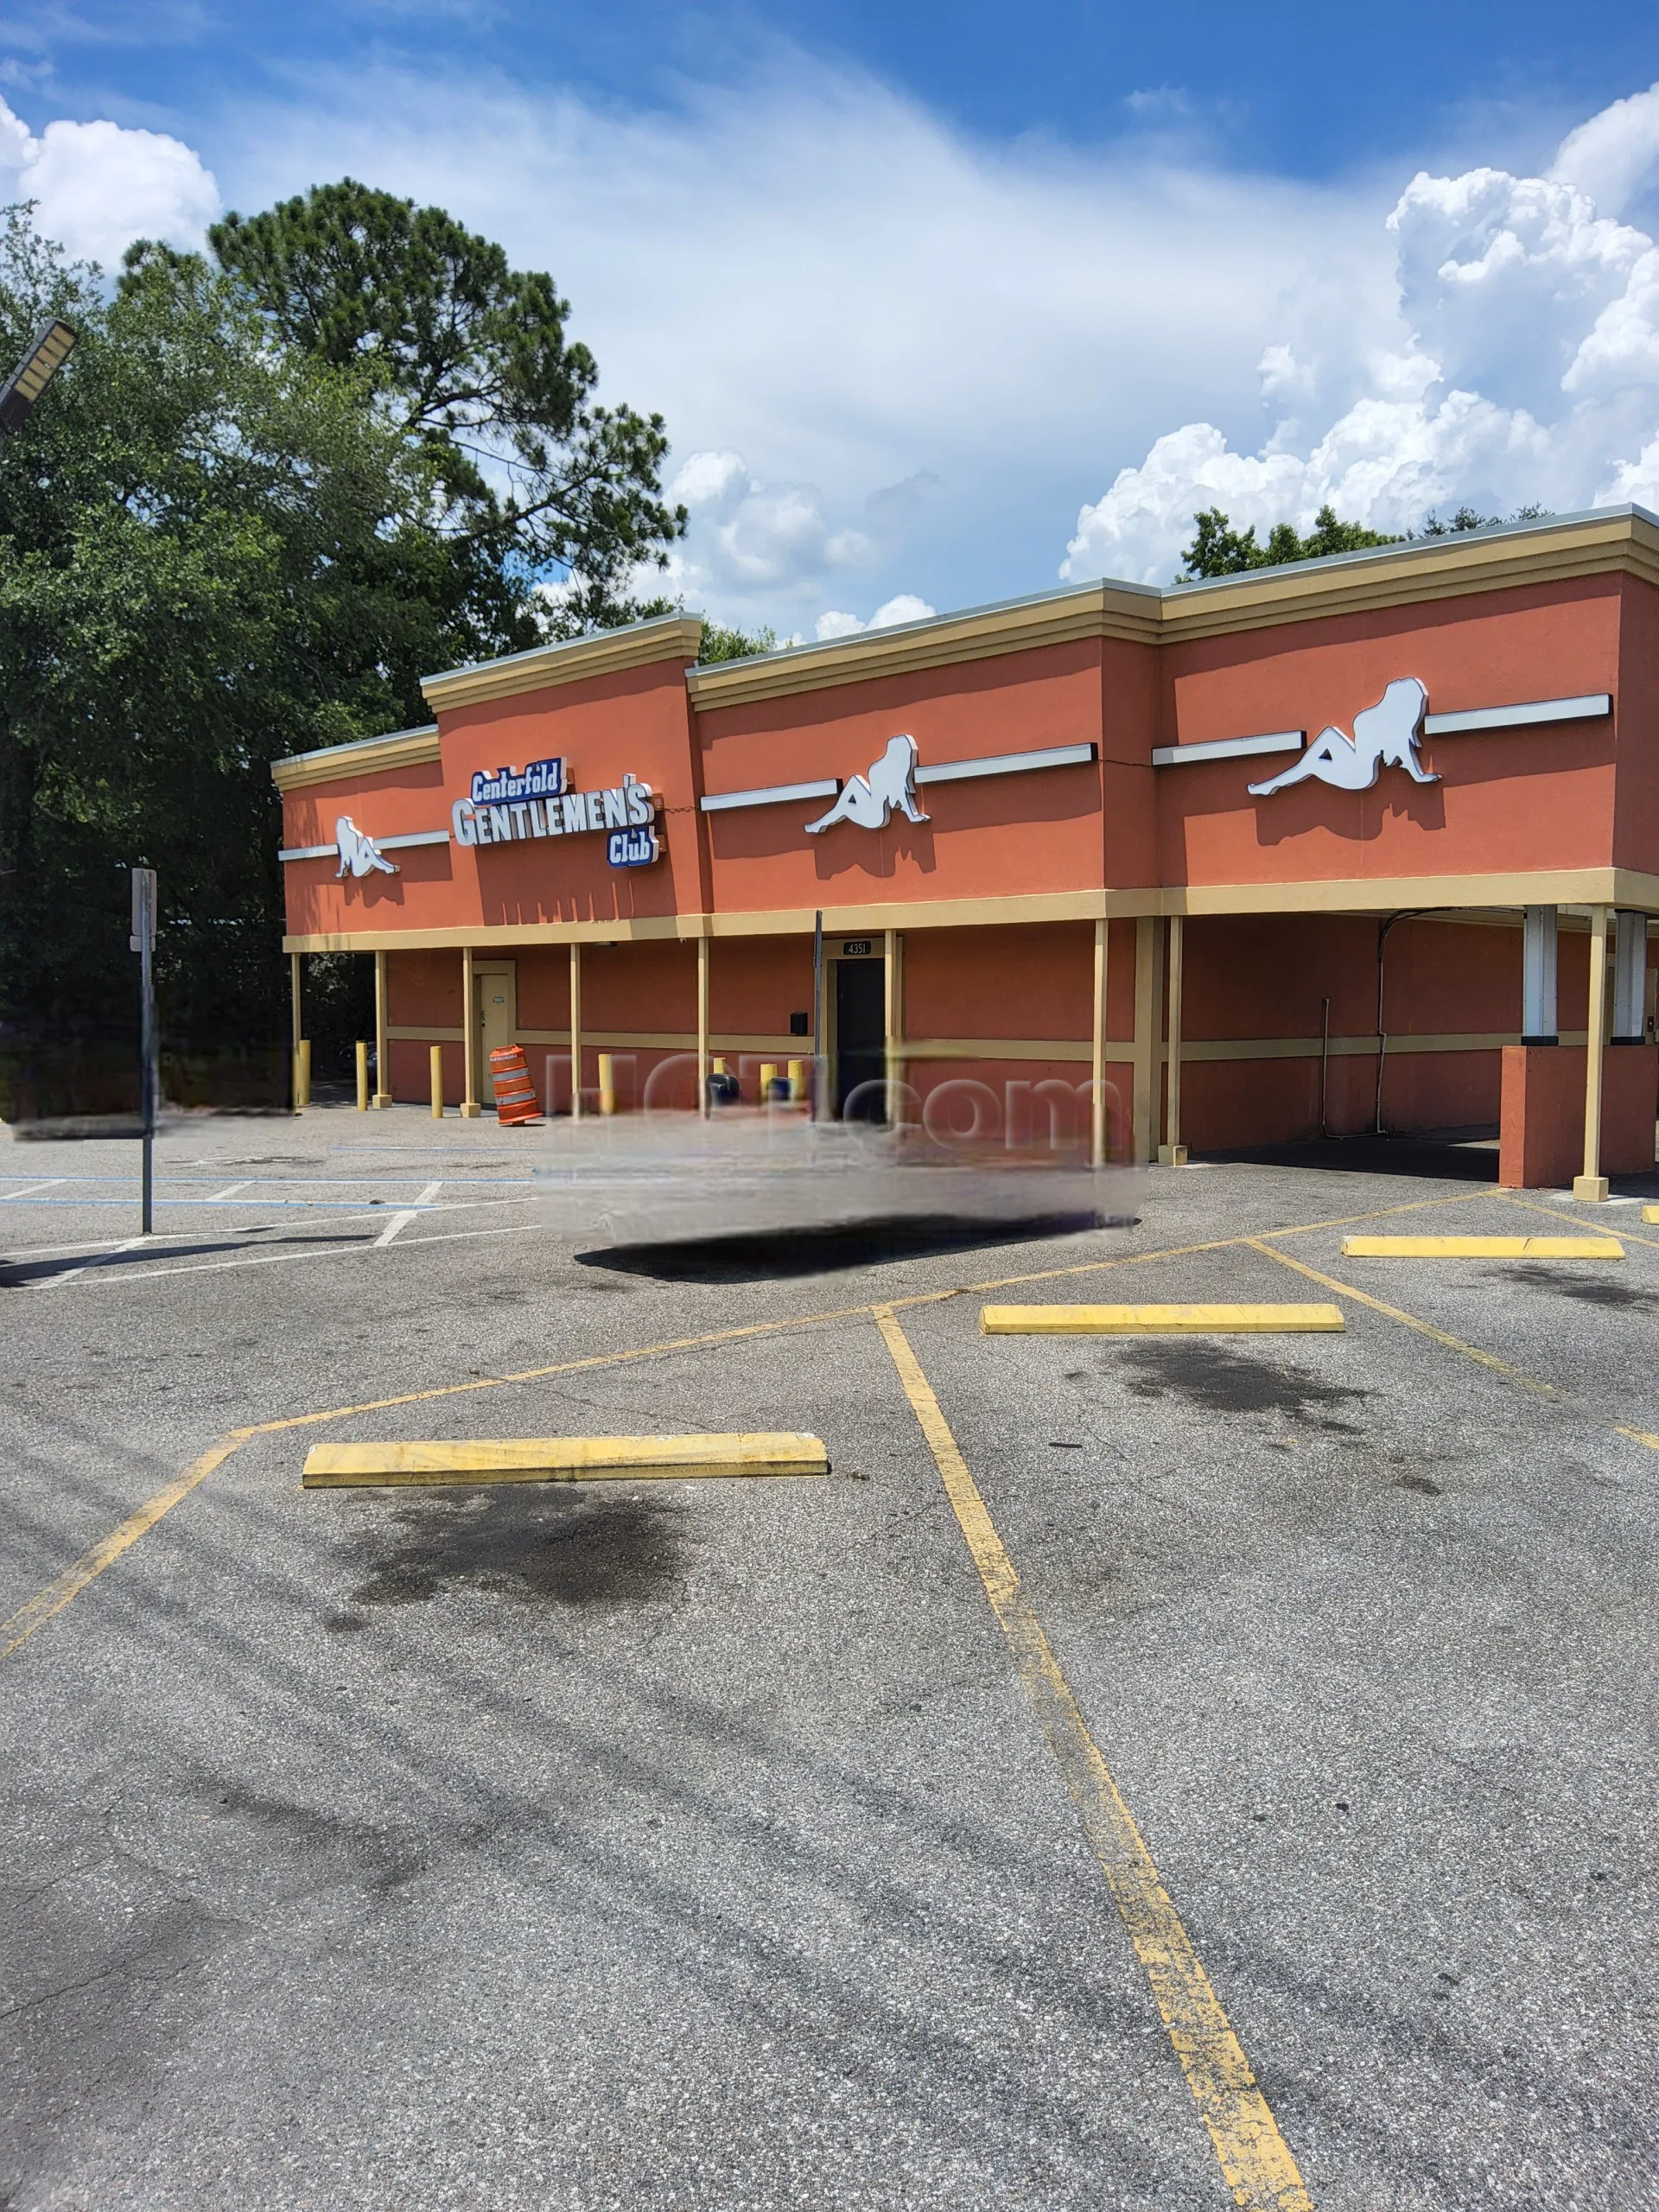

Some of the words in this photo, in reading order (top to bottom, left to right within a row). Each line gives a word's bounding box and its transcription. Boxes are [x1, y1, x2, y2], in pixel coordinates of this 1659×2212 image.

[473, 761, 558, 802] Centerfold
[452, 773, 652, 846] GENTLEMEN'S
[609, 830, 651, 864] Club
[849, 943, 866, 954] 4351
